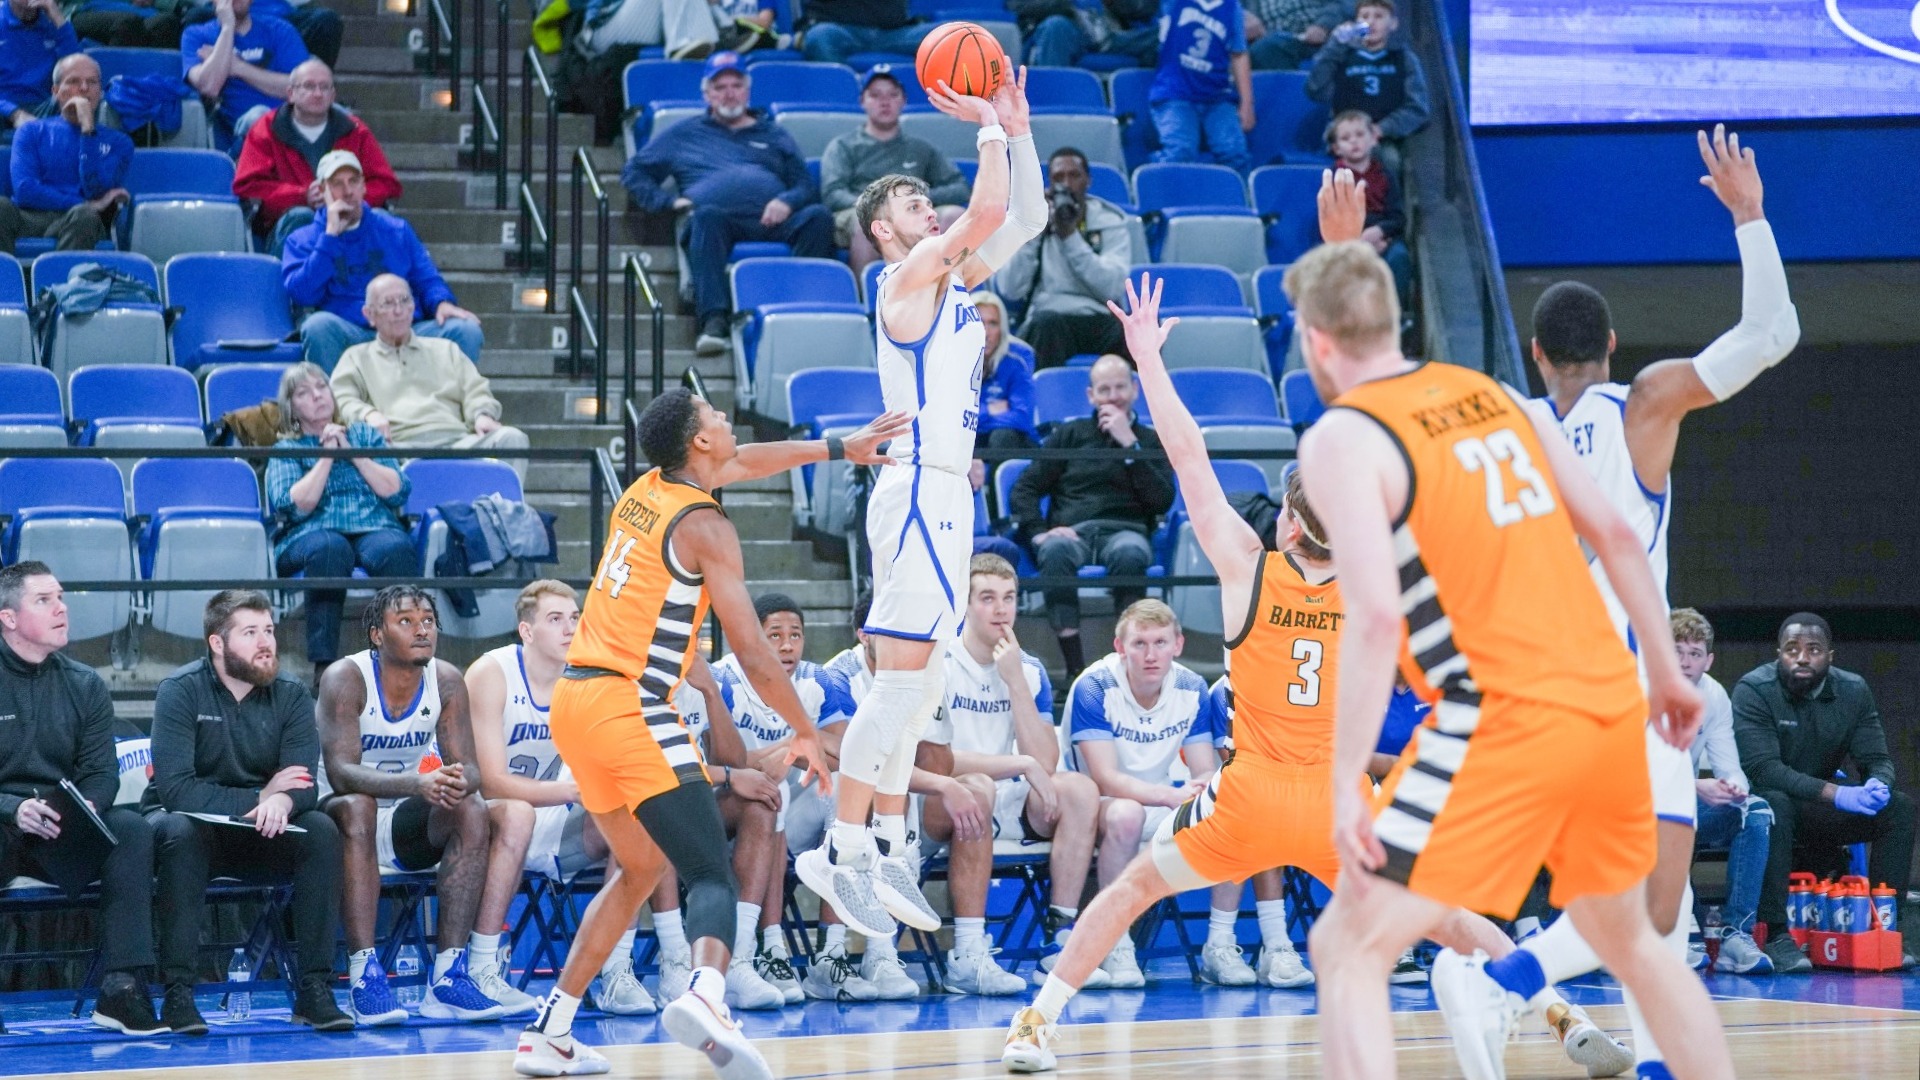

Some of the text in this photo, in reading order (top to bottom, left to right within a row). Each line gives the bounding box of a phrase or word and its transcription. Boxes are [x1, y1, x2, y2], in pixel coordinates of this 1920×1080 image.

[408, 28, 424, 52] G
[1187, 28, 1212, 59] 3
[985, 59, 1000, 101] ELIT
[1364, 75, 1380, 96] 3
[459, 124, 474, 147] F
[501, 221, 516, 245] E
[551, 326, 568, 349] D
[609, 435, 626, 461] C
[1566, 421, 1594, 456] EY
[1453, 427, 1557, 529] 23
[618, 497, 661, 535] GREEN
[595, 528, 638, 600] 14
[1287, 638, 1324, 708] 3
[507, 723, 552, 746] IND
[1824, 937, 1838, 961] G
